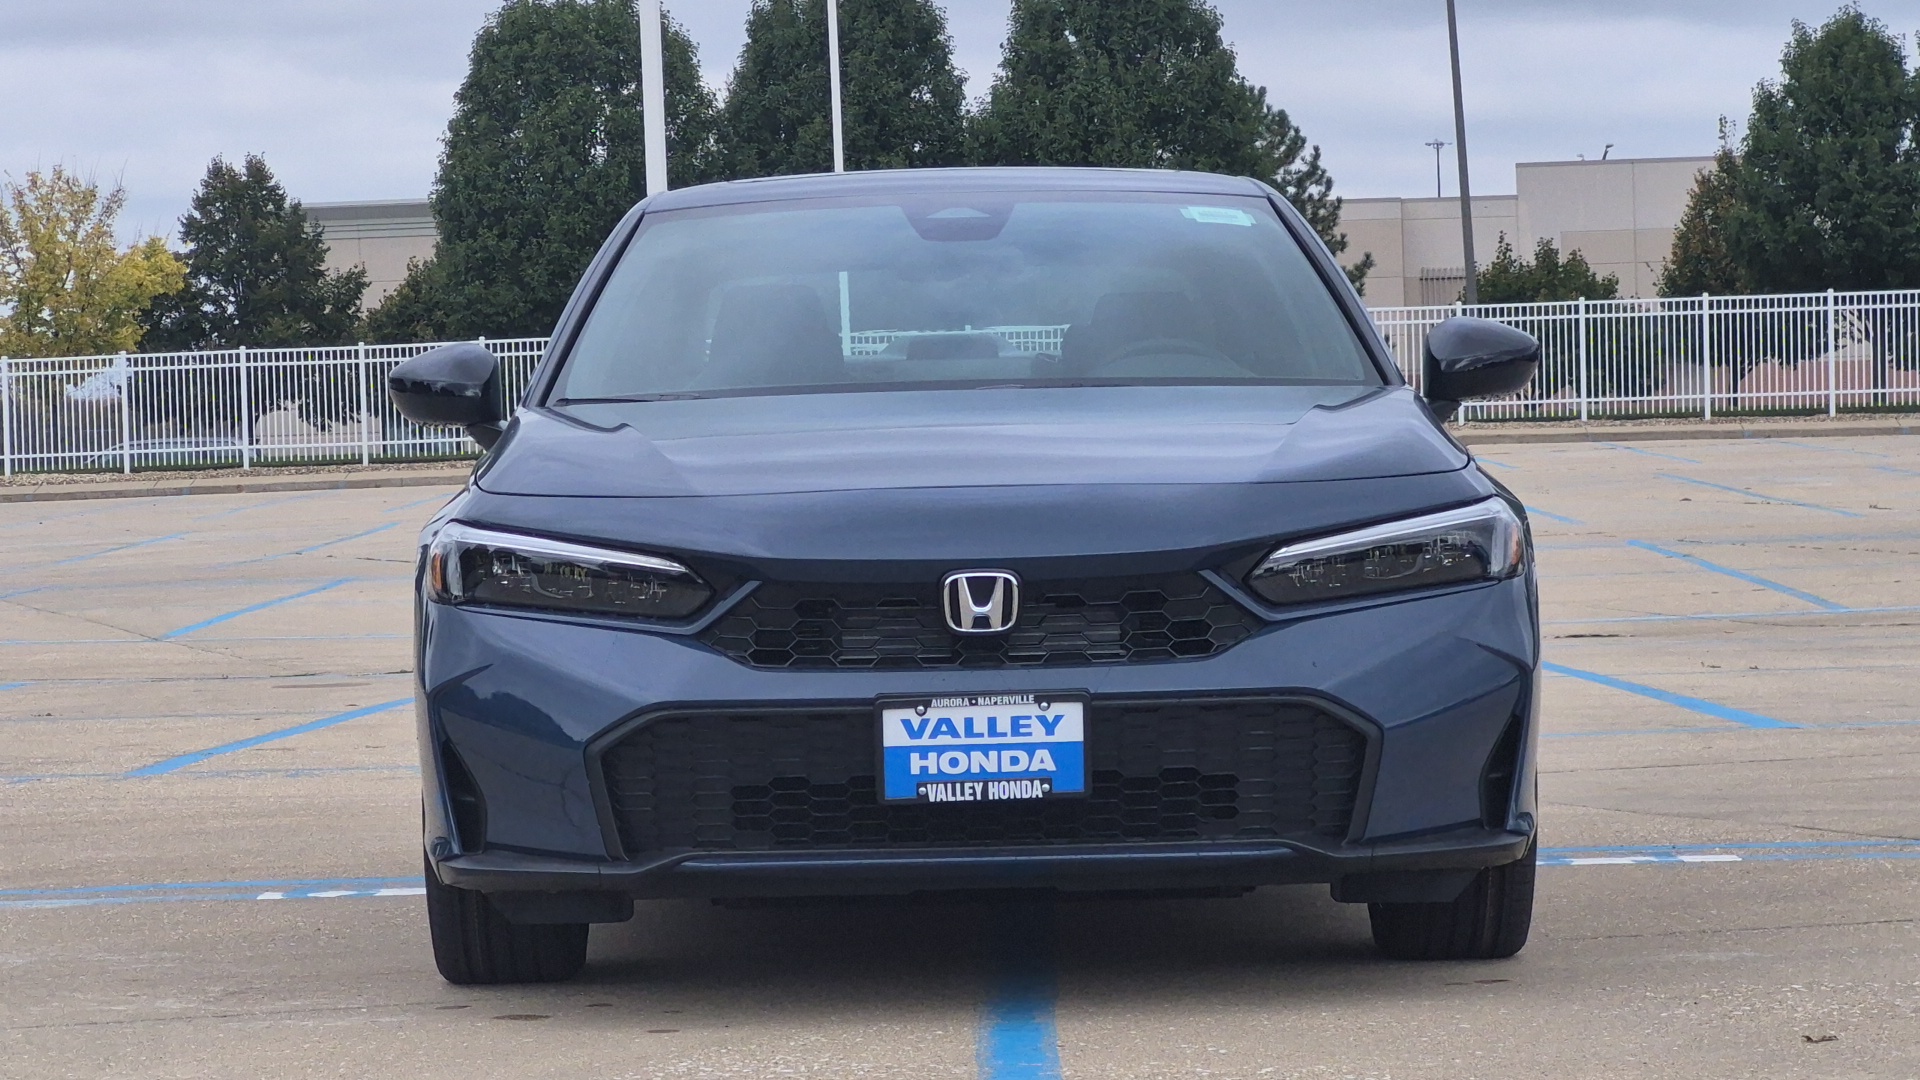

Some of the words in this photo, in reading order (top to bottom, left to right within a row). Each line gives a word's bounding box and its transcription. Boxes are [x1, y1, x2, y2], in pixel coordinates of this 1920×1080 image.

[931, 698, 969, 708] AURORA
[978, 695, 1035, 706] NAPERVILLE
[900, 714, 1065, 740] VALLEY
[910, 749, 1057, 775] HONDA
[927, 782, 984, 802] VALLEY
[988, 780, 1043, 800] HONDA
